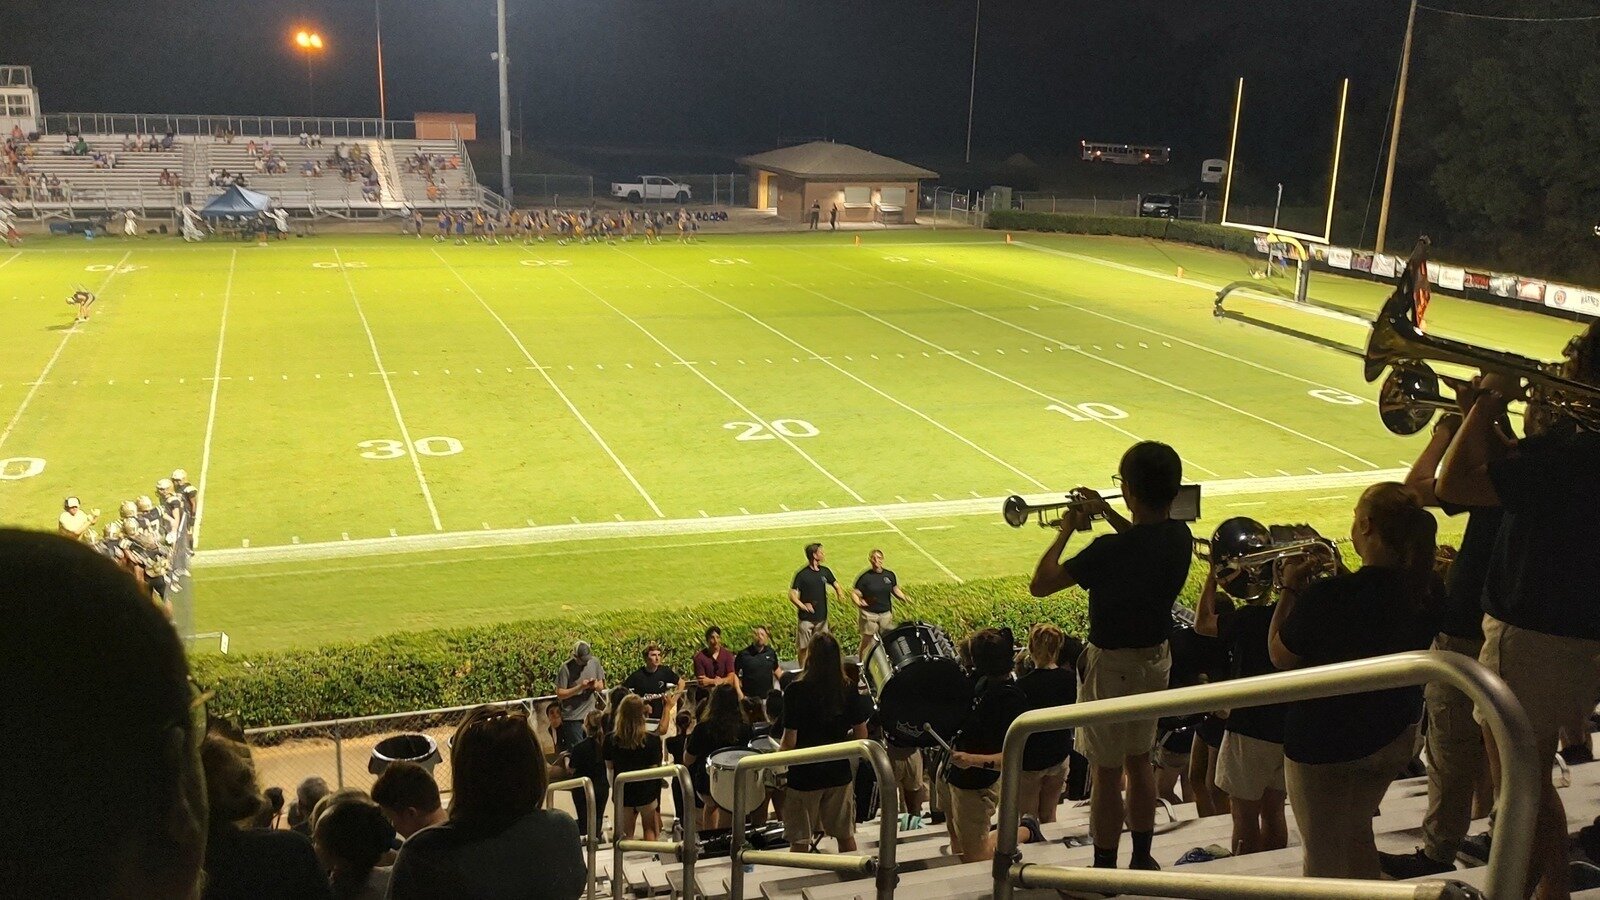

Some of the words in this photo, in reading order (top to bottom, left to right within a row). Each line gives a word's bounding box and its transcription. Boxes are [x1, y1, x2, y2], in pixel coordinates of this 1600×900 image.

[1307, 389, 1364, 405] G
[1044, 402, 1130, 421] 10
[723, 419, 820, 441] 20
[357, 436, 464, 459] 30
